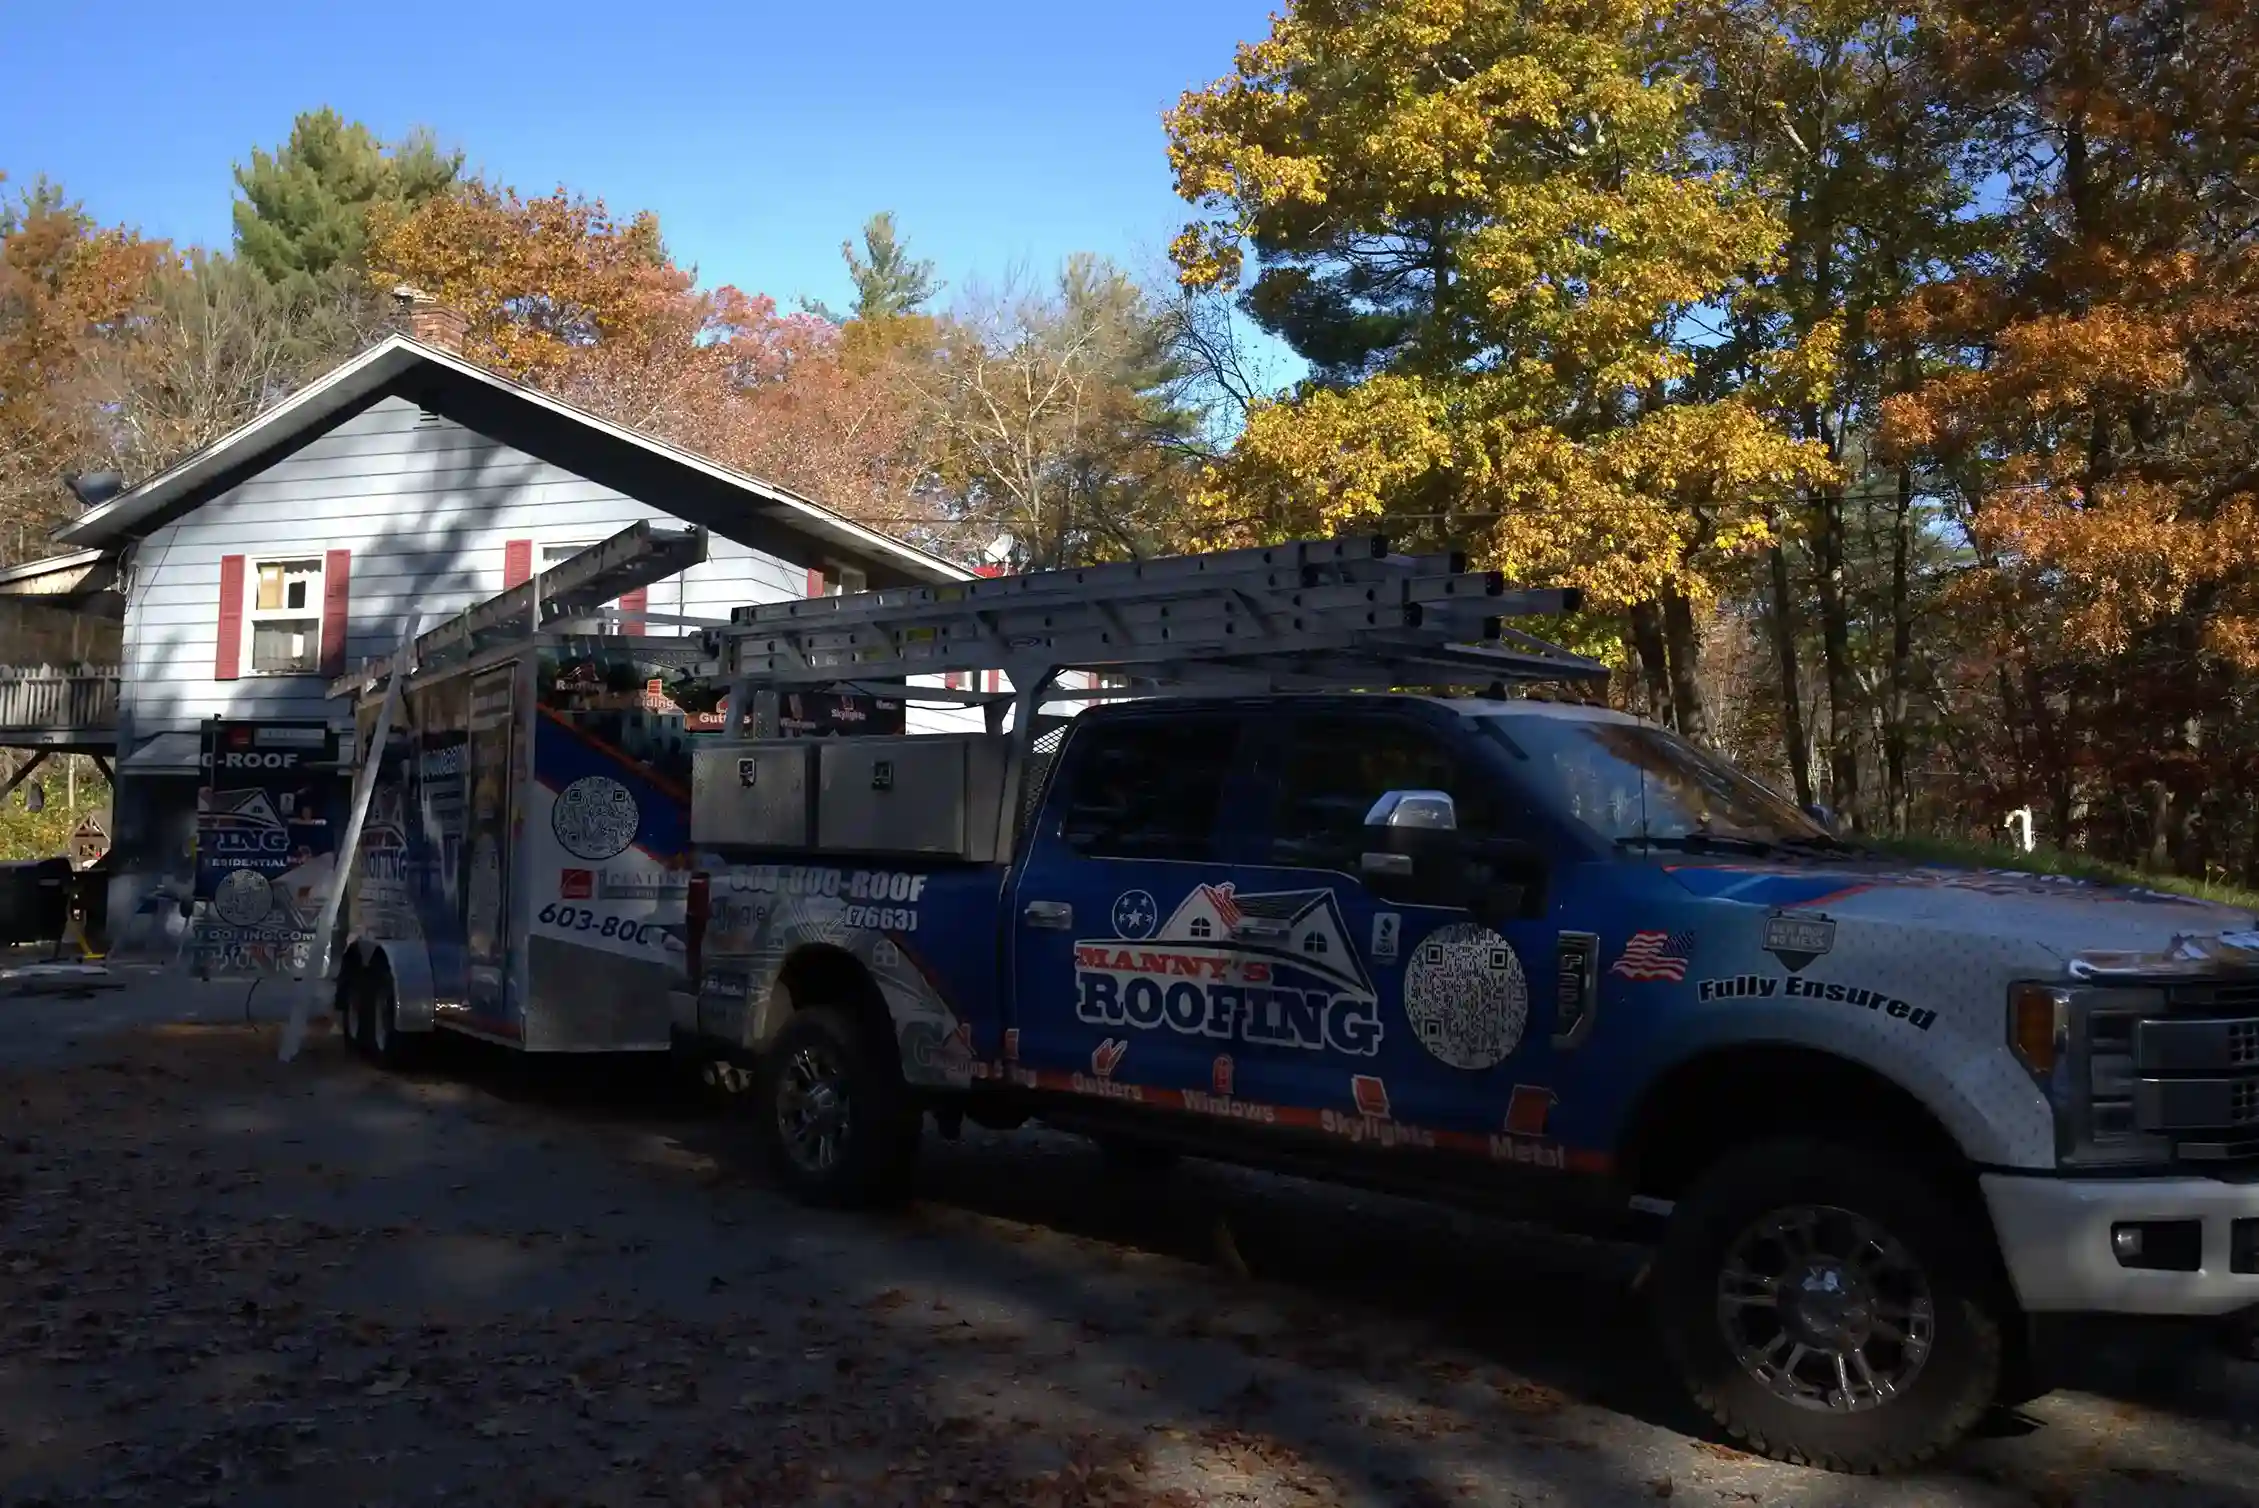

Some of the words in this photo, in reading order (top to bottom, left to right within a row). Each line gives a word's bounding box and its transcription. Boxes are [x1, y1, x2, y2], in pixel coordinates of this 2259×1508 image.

[699, 711, 753, 725] Guts
[1076, 948, 1270, 982] MANNY'S
[1077, 972, 1383, 1056] ROOFING
[1698, 975, 1777, 1002] Fully
[1784, 976, 1939, 1032] Ensured
[1181, 1088, 1276, 1124] Windows
[1320, 1107, 1436, 1148] Skylights
[1489, 1132, 1566, 1171] Metal
